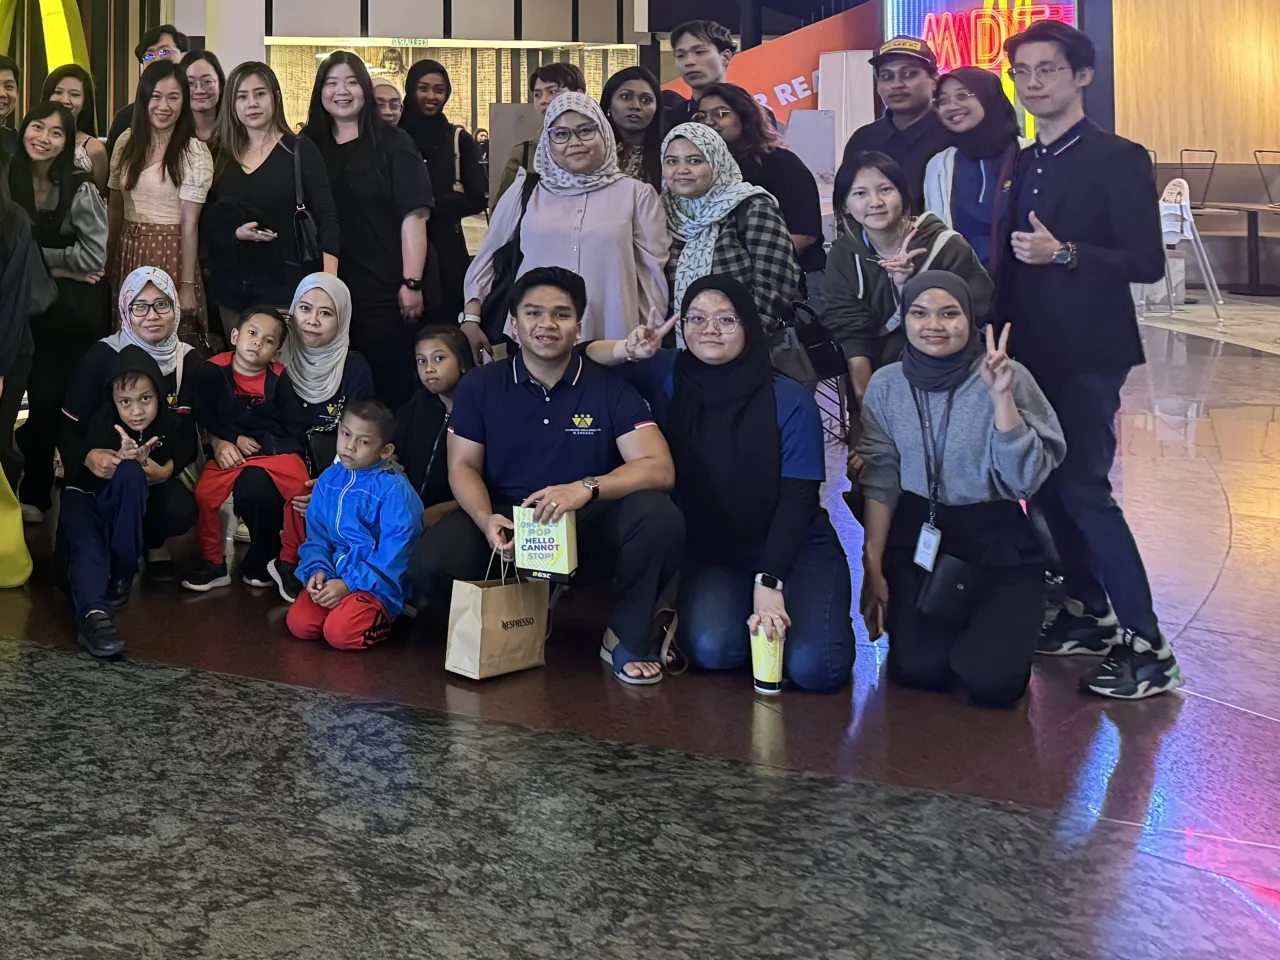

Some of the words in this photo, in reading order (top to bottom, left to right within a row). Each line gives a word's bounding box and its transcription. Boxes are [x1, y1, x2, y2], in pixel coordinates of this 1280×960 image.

[528, 528, 552, 537] POP
[525, 537, 555, 545] HELLO
[521, 544, 560, 552] CANNOT
[537, 571, 552, 579] GSC
[501, 616, 535, 631] NESPRESSO
